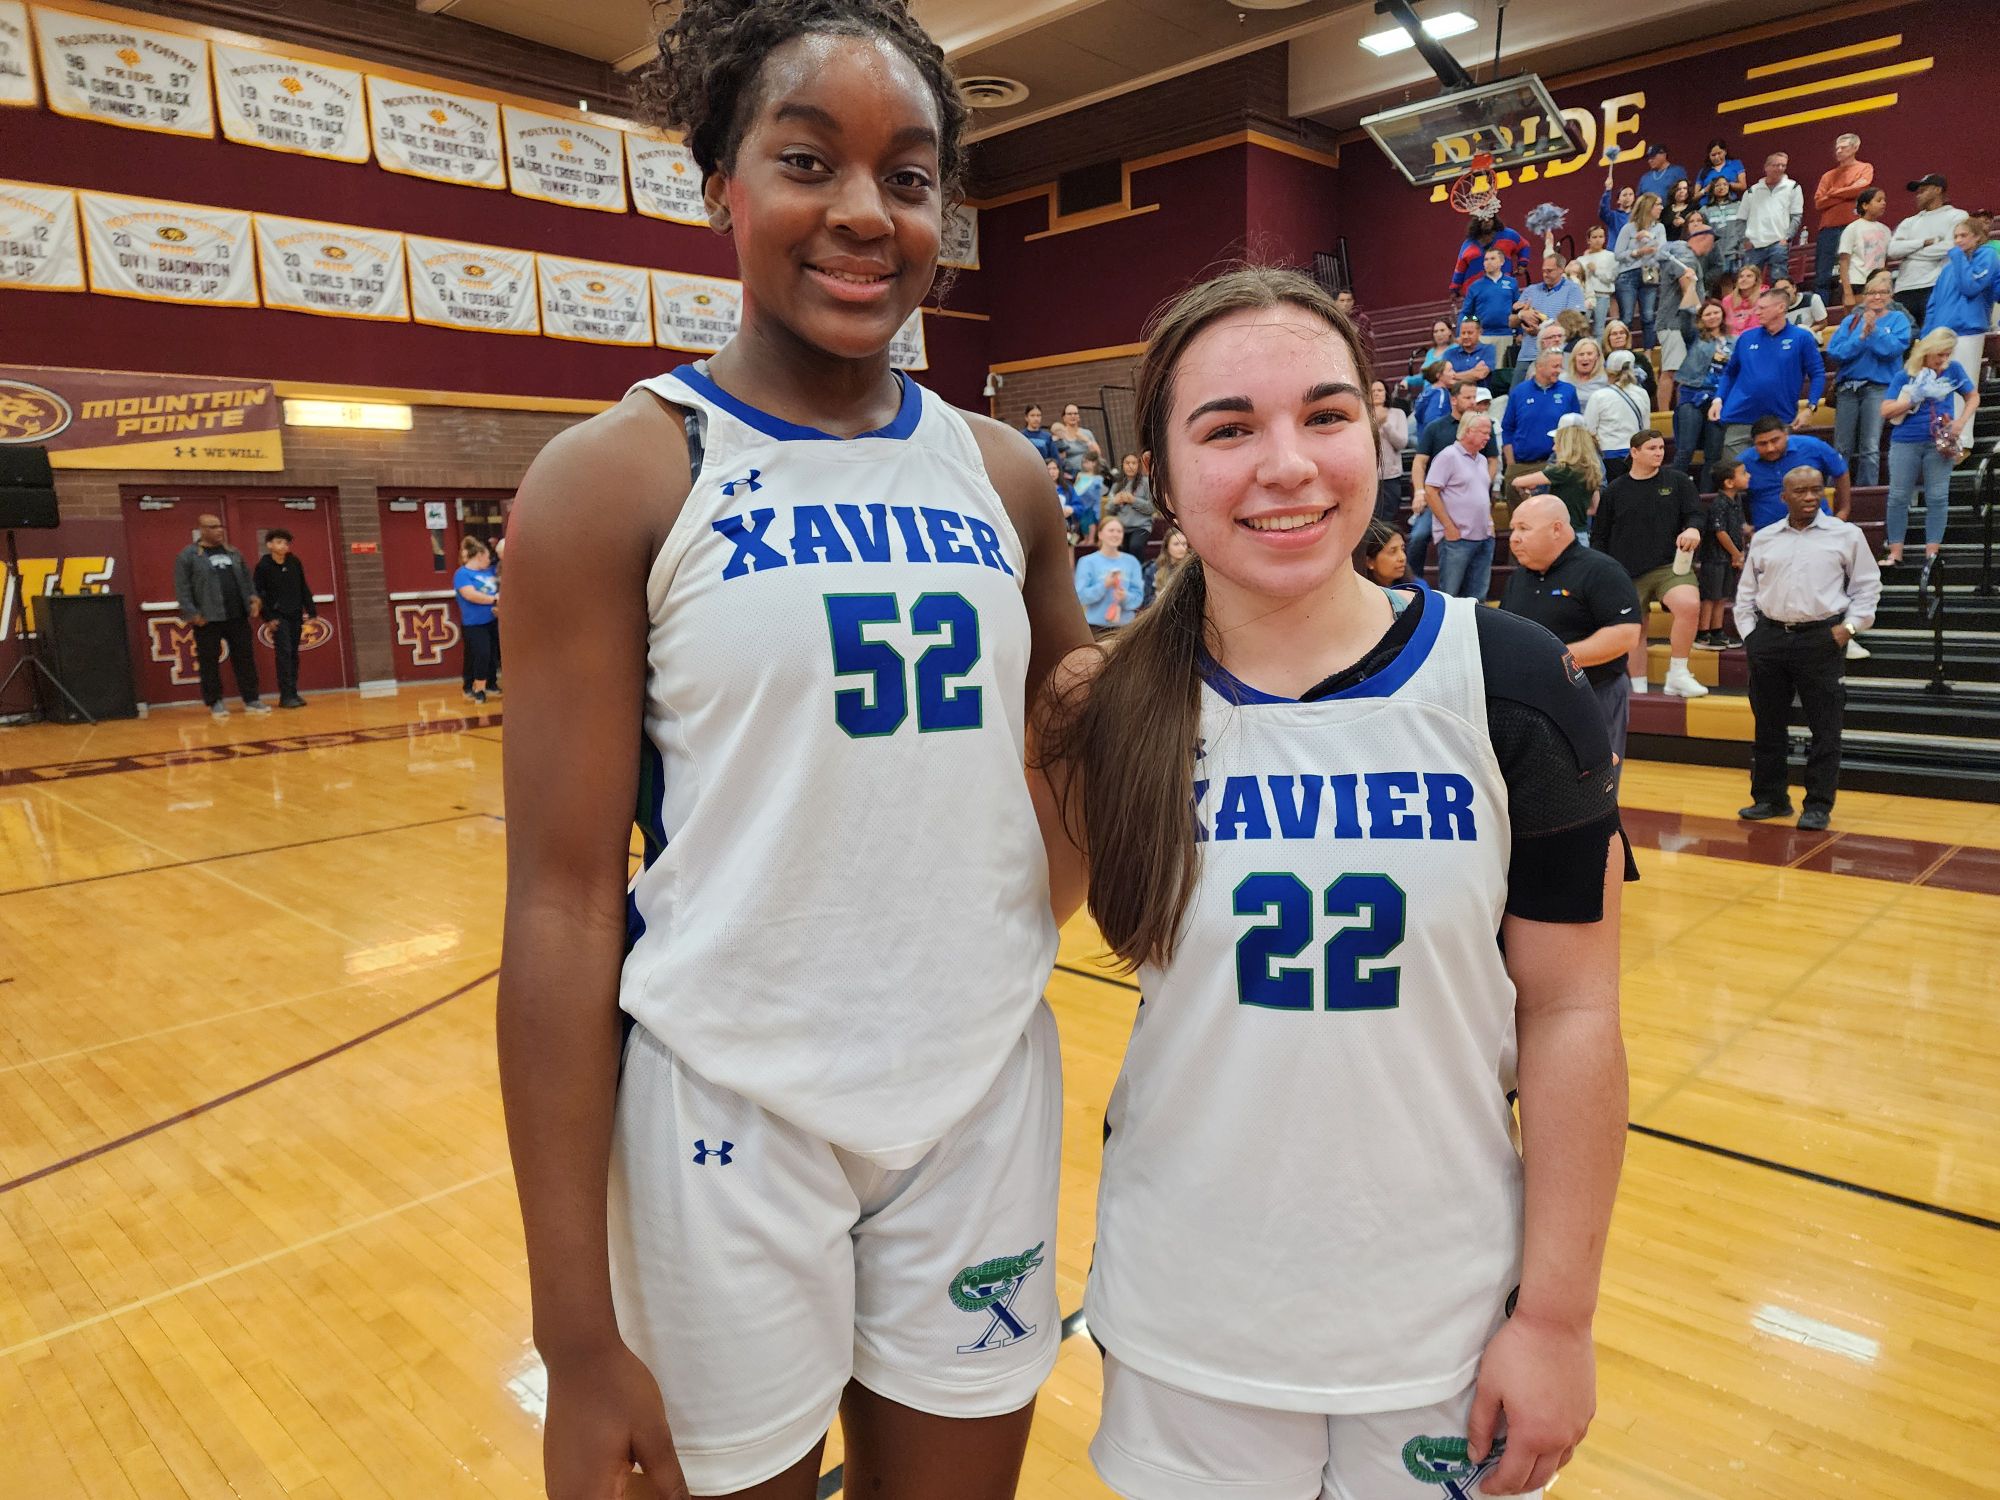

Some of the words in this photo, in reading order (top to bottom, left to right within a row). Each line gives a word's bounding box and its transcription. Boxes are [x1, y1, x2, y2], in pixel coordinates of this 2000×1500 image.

[105, 66, 156, 84] PRIDE
[230, 64, 298, 77] MOUNTAIN
[91, 78, 135, 99] GIRLS
[145, 87, 190, 108] TRACK
[239, 84, 257, 100] 19
[273, 94, 314, 110] PRIDE
[270, 109, 304, 128] GIRLS
[309, 117, 344, 134] TRACK
[518, 126, 572, 138] MOUNTAIN
[434, 140, 498, 160] BASKETBALL
[554, 166, 582, 182] CROSS
[32, 226, 49, 242] 12
[112, 232, 132, 248] 20
[215, 244, 230, 258] 13
[158, 258, 230, 277] BADMINTON
[283, 252, 300, 268] 20
[310, 272, 344, 290] GIRLS
[350, 278, 384, 292] TRACK
[462, 292, 514, 308] FOOTBALL
[81, 388, 266, 420] MOUNTAIN
[116, 408, 246, 437] POINTE
[204, 448, 227, 458] WE
[711, 503, 1015, 582] XAVIER
[822, 591, 983, 739] 52
[1232, 871, 1407, 1012] 22
